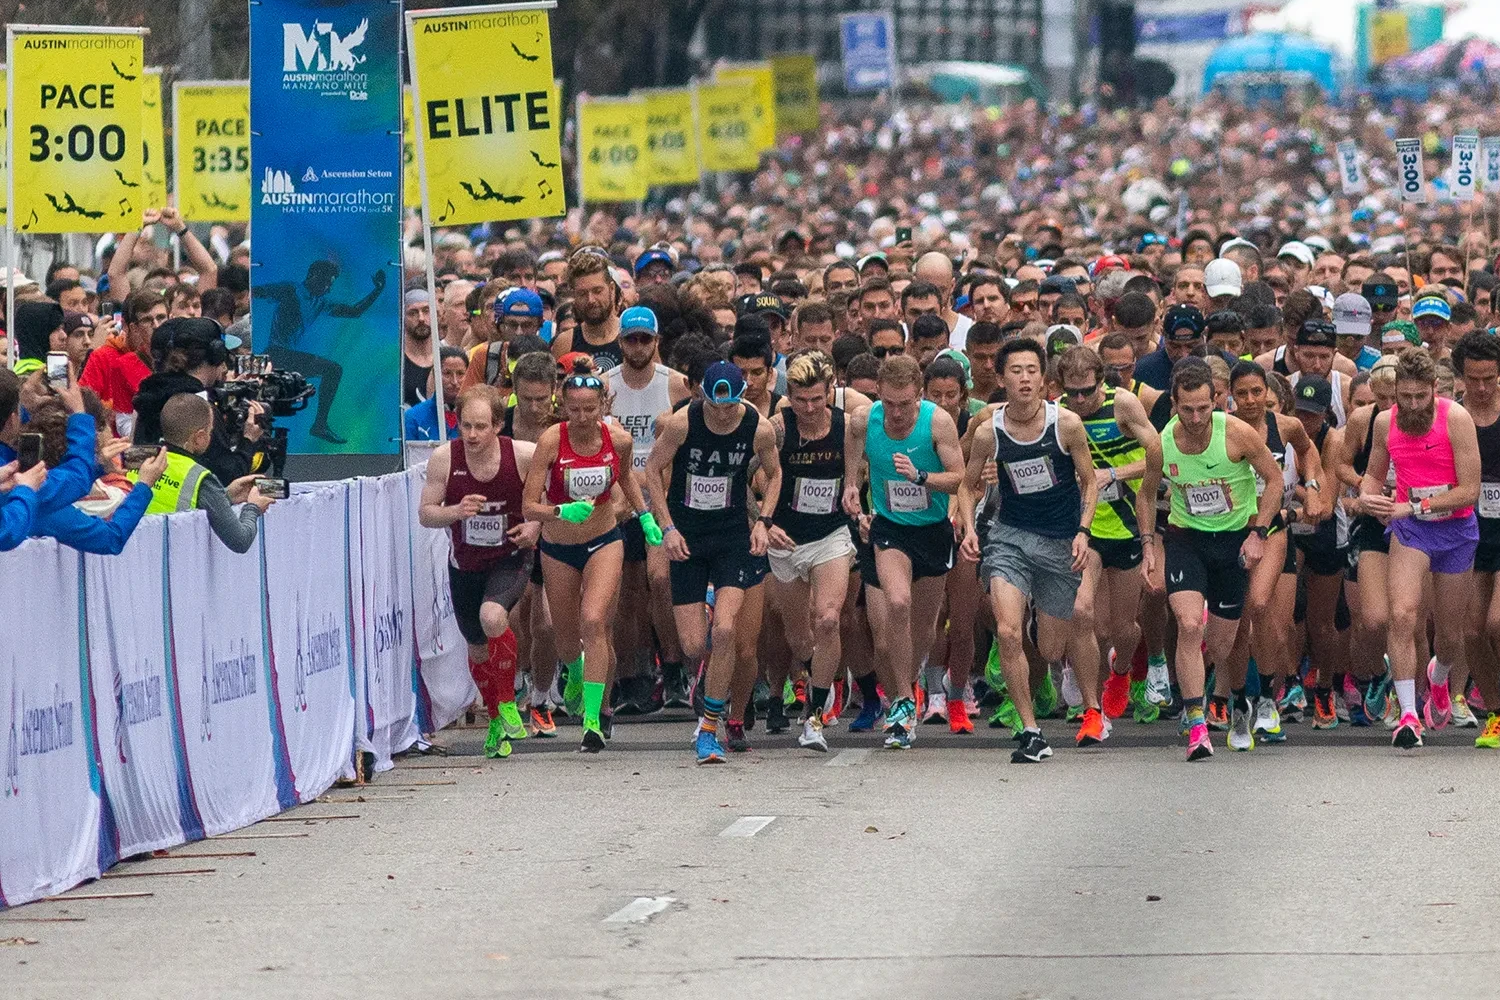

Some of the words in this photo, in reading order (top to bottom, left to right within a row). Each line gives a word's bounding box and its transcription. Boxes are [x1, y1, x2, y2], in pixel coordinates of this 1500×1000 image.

[282, 82, 339, 90] MANZANO
[344, 82, 368, 90] MILE
[40, 84, 115, 109] PACE
[426, 90, 551, 140] ELITE
[195, 118, 246, 136] PACE
[29, 124, 126, 162] 3:00
[192, 146, 249, 173] 3:35
[588, 144, 639, 165] 4:00
[321, 169, 366, 178] Ascension
[367, 170, 393, 179] Seton
[1402, 153, 1420, 193] 3:00
[1457, 150, 1473, 186] 3:10
[382, 205, 393, 213] 5K
[1013, 464, 1045, 478] 10032
[572, 475, 603, 488] 10023
[692, 482, 724, 493] 10006
[802, 486, 833, 497] 10022
[892, 486, 924, 497] 10021
[1191, 491, 1219, 503] 10017
[468, 519, 501, 531] 18460
